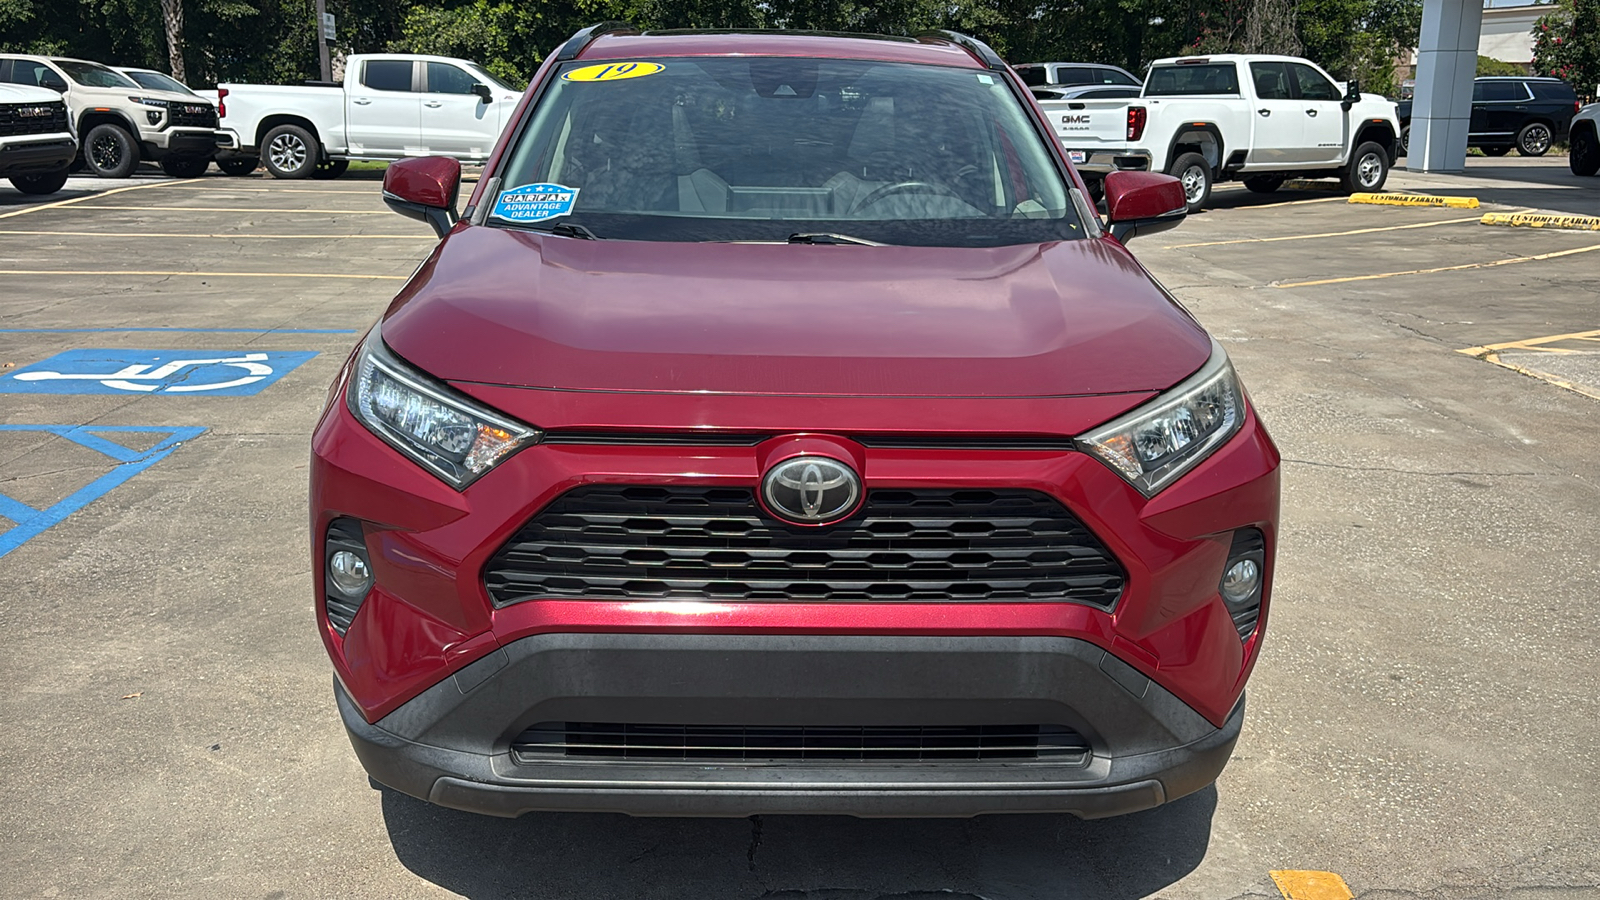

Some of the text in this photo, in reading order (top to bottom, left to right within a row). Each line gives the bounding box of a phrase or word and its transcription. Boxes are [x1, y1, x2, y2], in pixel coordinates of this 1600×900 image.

[594, 63, 638, 79] 19
[1061, 115, 1091, 123] GMC
[502, 193, 571, 203] CARFAX
[1370, 194, 1445, 204] CUSTOMER PARKING
[504, 202, 562, 212] ADVANTAGE
[511, 210, 549, 218] DEALER
[1510, 214, 1561, 223] CUSTOMER
